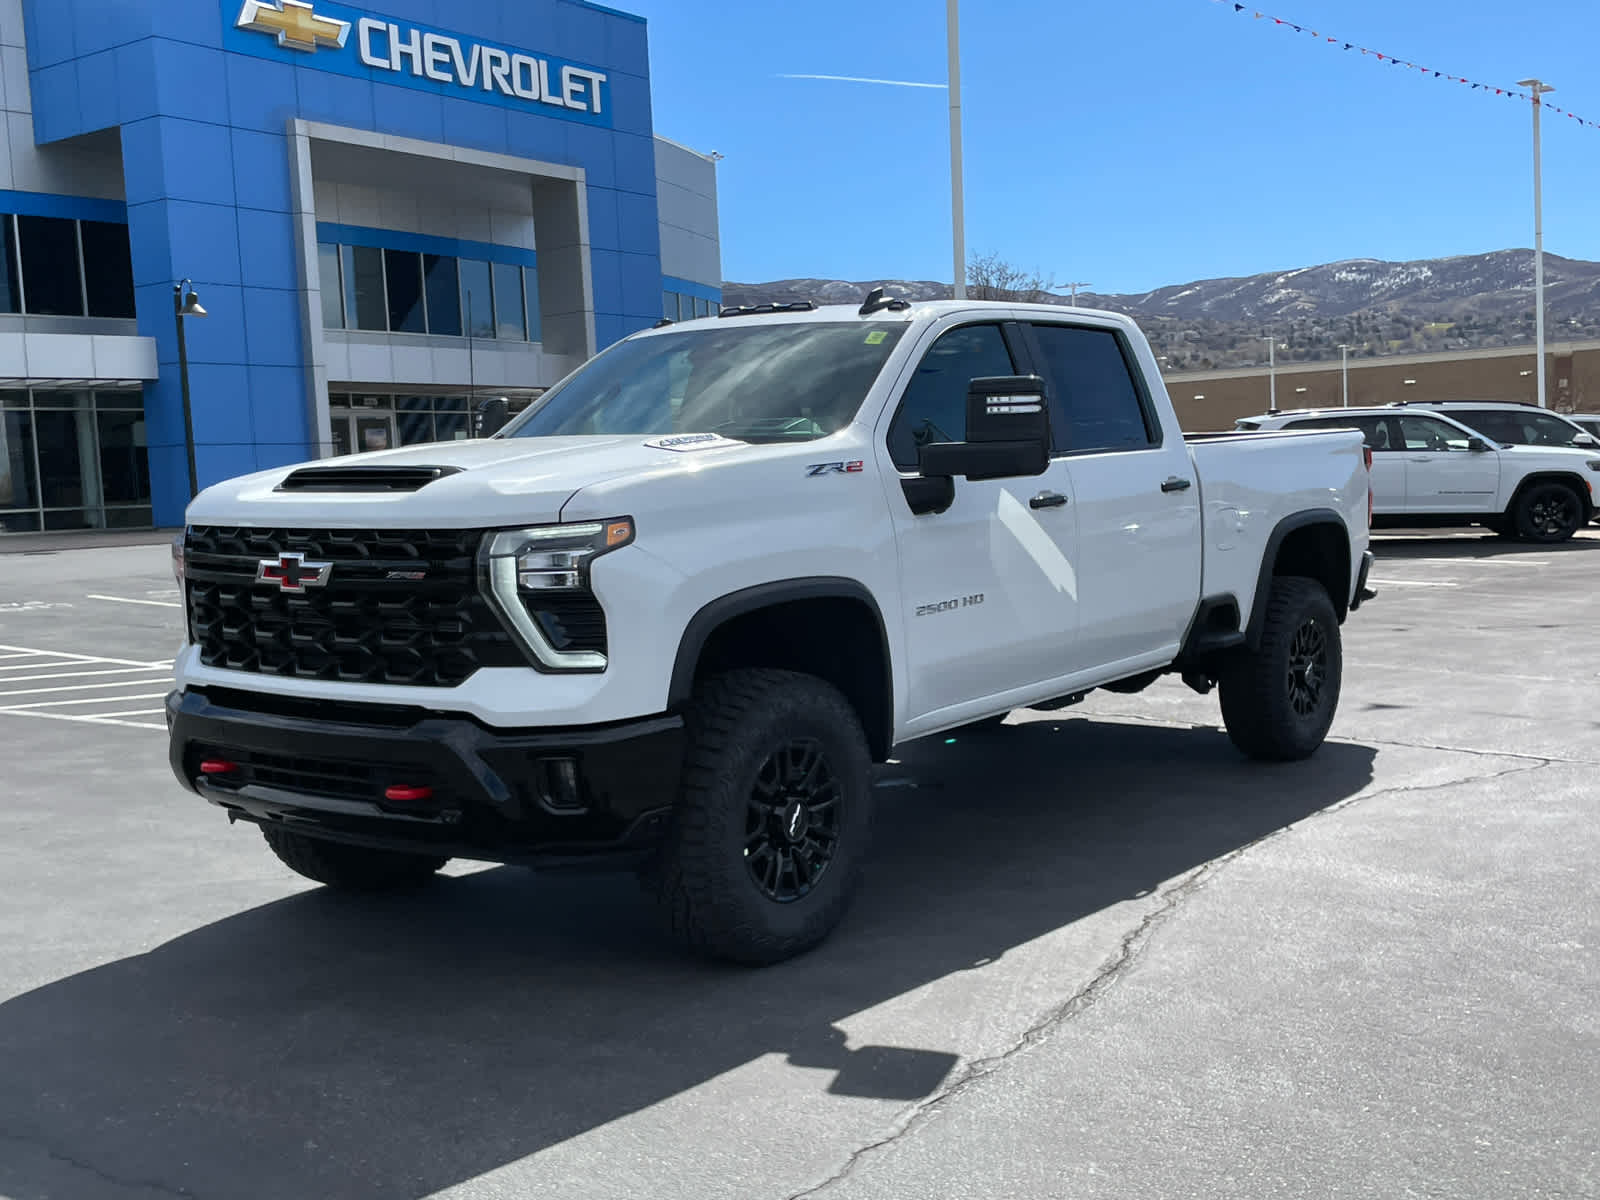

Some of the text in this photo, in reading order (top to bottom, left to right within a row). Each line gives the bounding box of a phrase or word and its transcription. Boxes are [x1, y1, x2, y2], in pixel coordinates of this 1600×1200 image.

[358, 17, 606, 114] CHEVROLET
[806, 460, 864, 476] ZR2
[915, 593, 985, 616] 2500 HD
